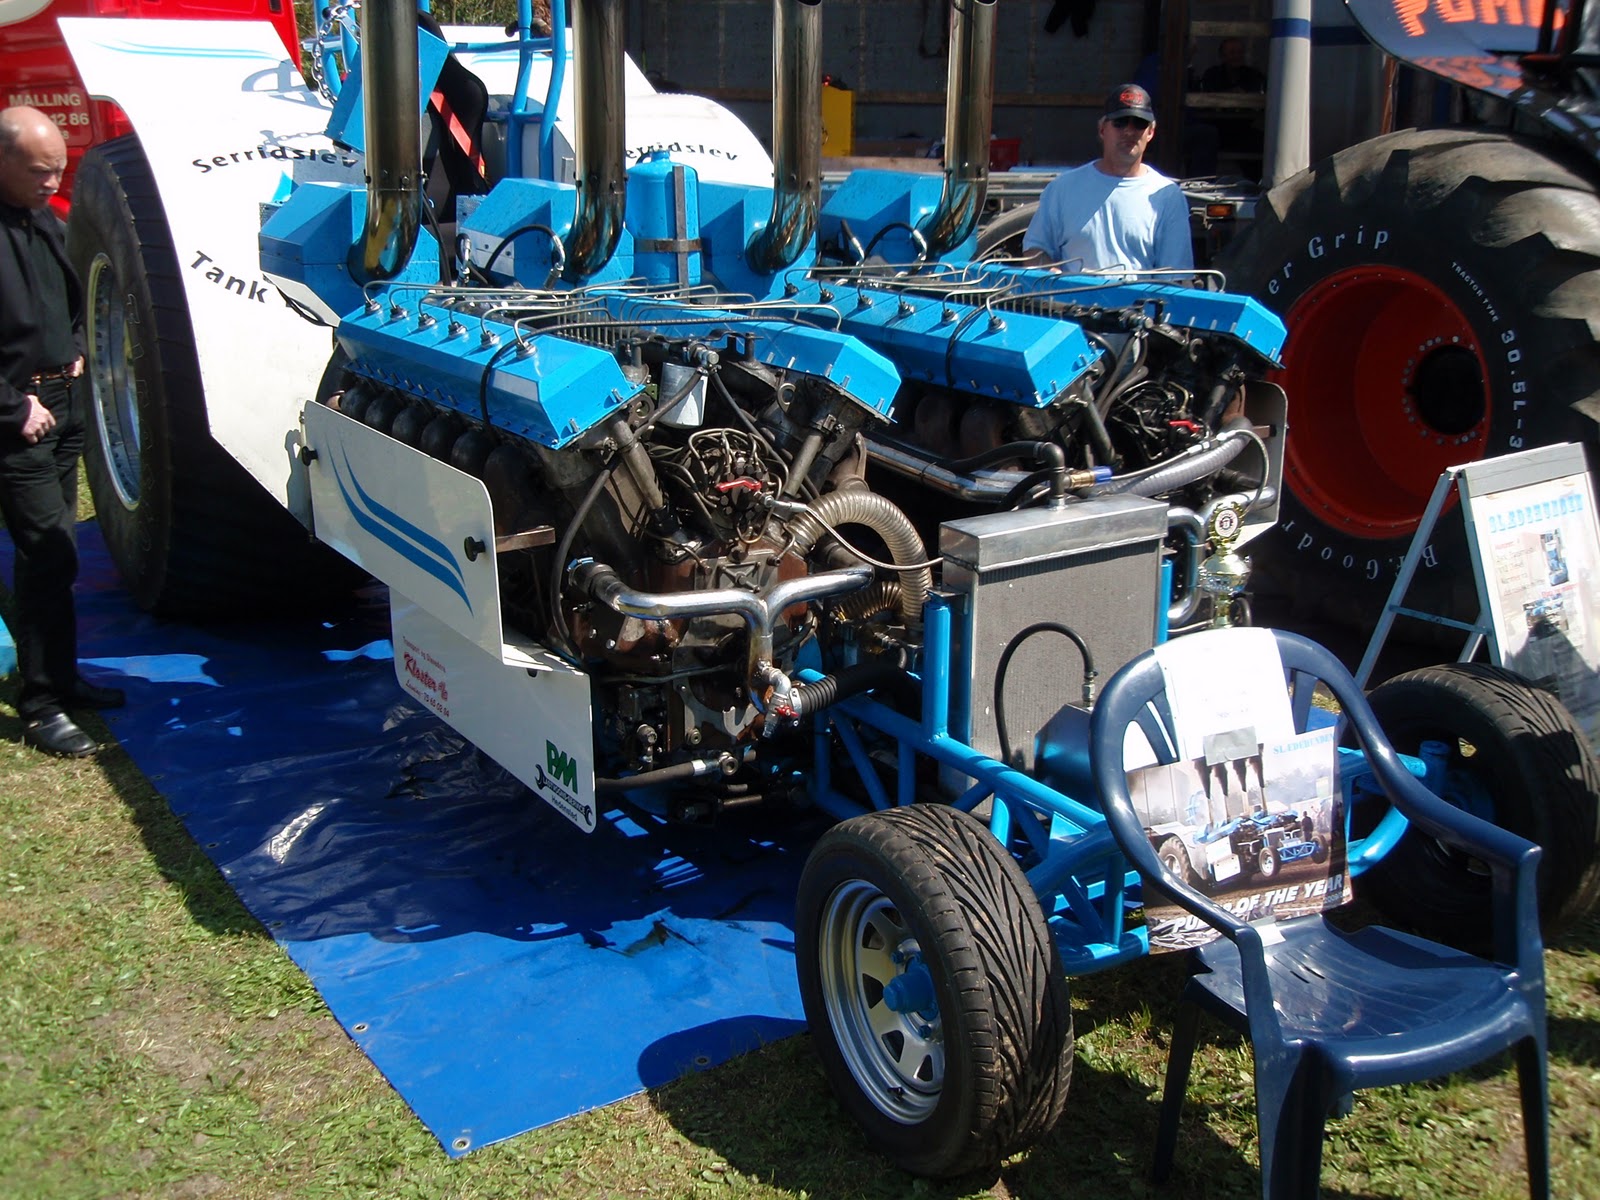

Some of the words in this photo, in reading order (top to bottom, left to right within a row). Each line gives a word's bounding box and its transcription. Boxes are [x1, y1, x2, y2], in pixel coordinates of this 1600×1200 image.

[8, 92, 82, 107] MALLING
[69, 112, 90, 126] 86
[624, 141, 738, 161] erridslev
[1307, 224, 1389, 259] Grip
[190, 249, 269, 304] Tank
[1452, 261, 1484, 298] TRACTOR
[1482, 297, 1500, 324] TYPE
[1235, 893, 1261, 914] OF
[1262, 885, 1300, 907] THE
[1303, 873, 1343, 899] YEAR
